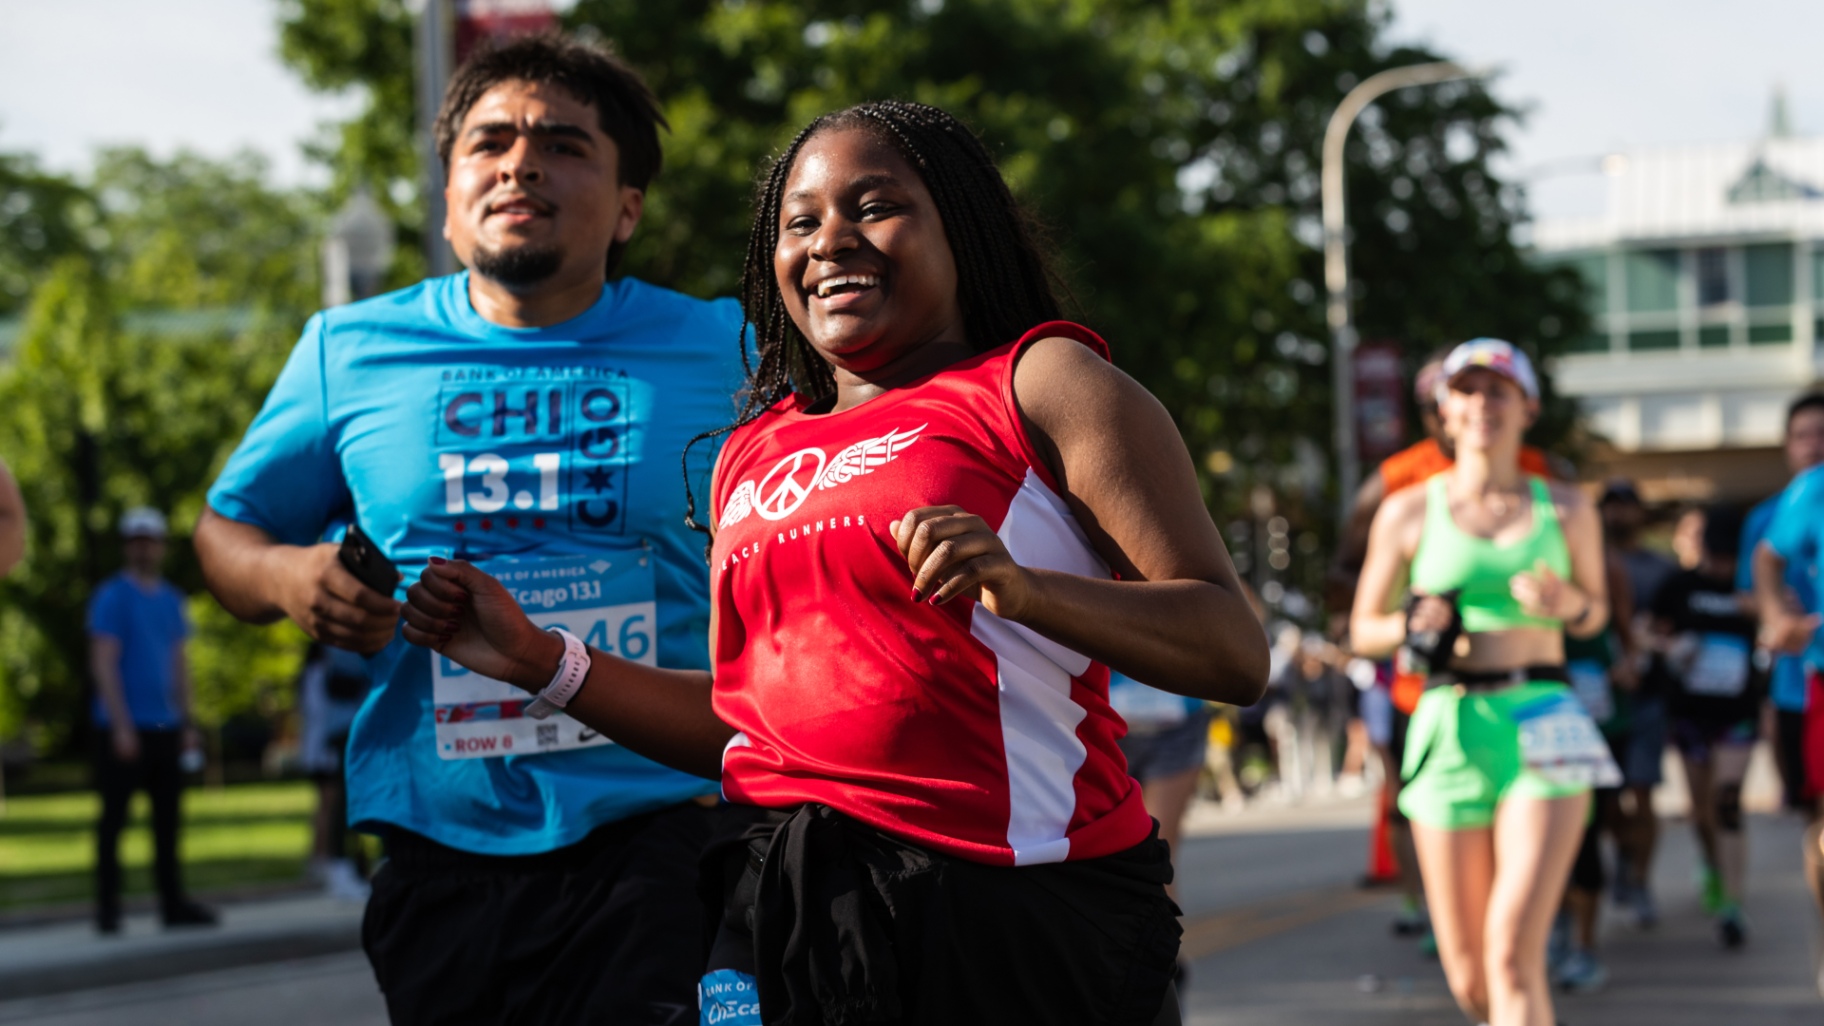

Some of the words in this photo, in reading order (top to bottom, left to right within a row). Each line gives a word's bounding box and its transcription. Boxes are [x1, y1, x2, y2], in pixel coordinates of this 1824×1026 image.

[441, 369, 496, 381] BANK
[535, 365, 629, 379] AMERICA
[444, 391, 562, 436] CHI
[438, 453, 560, 514] 13.1
[717, 542, 760, 577] EACE
[777, 515, 865, 544] RUNNERS
[514, 571, 529, 580] OF
[532, 566, 587, 579] AMERICA
[509, 587, 568, 608] cago
[569, 580, 602, 600] 13.1
[455, 737, 497, 753] ROW
[502, 734, 513, 749] 8
[736, 981, 753, 991] OF
